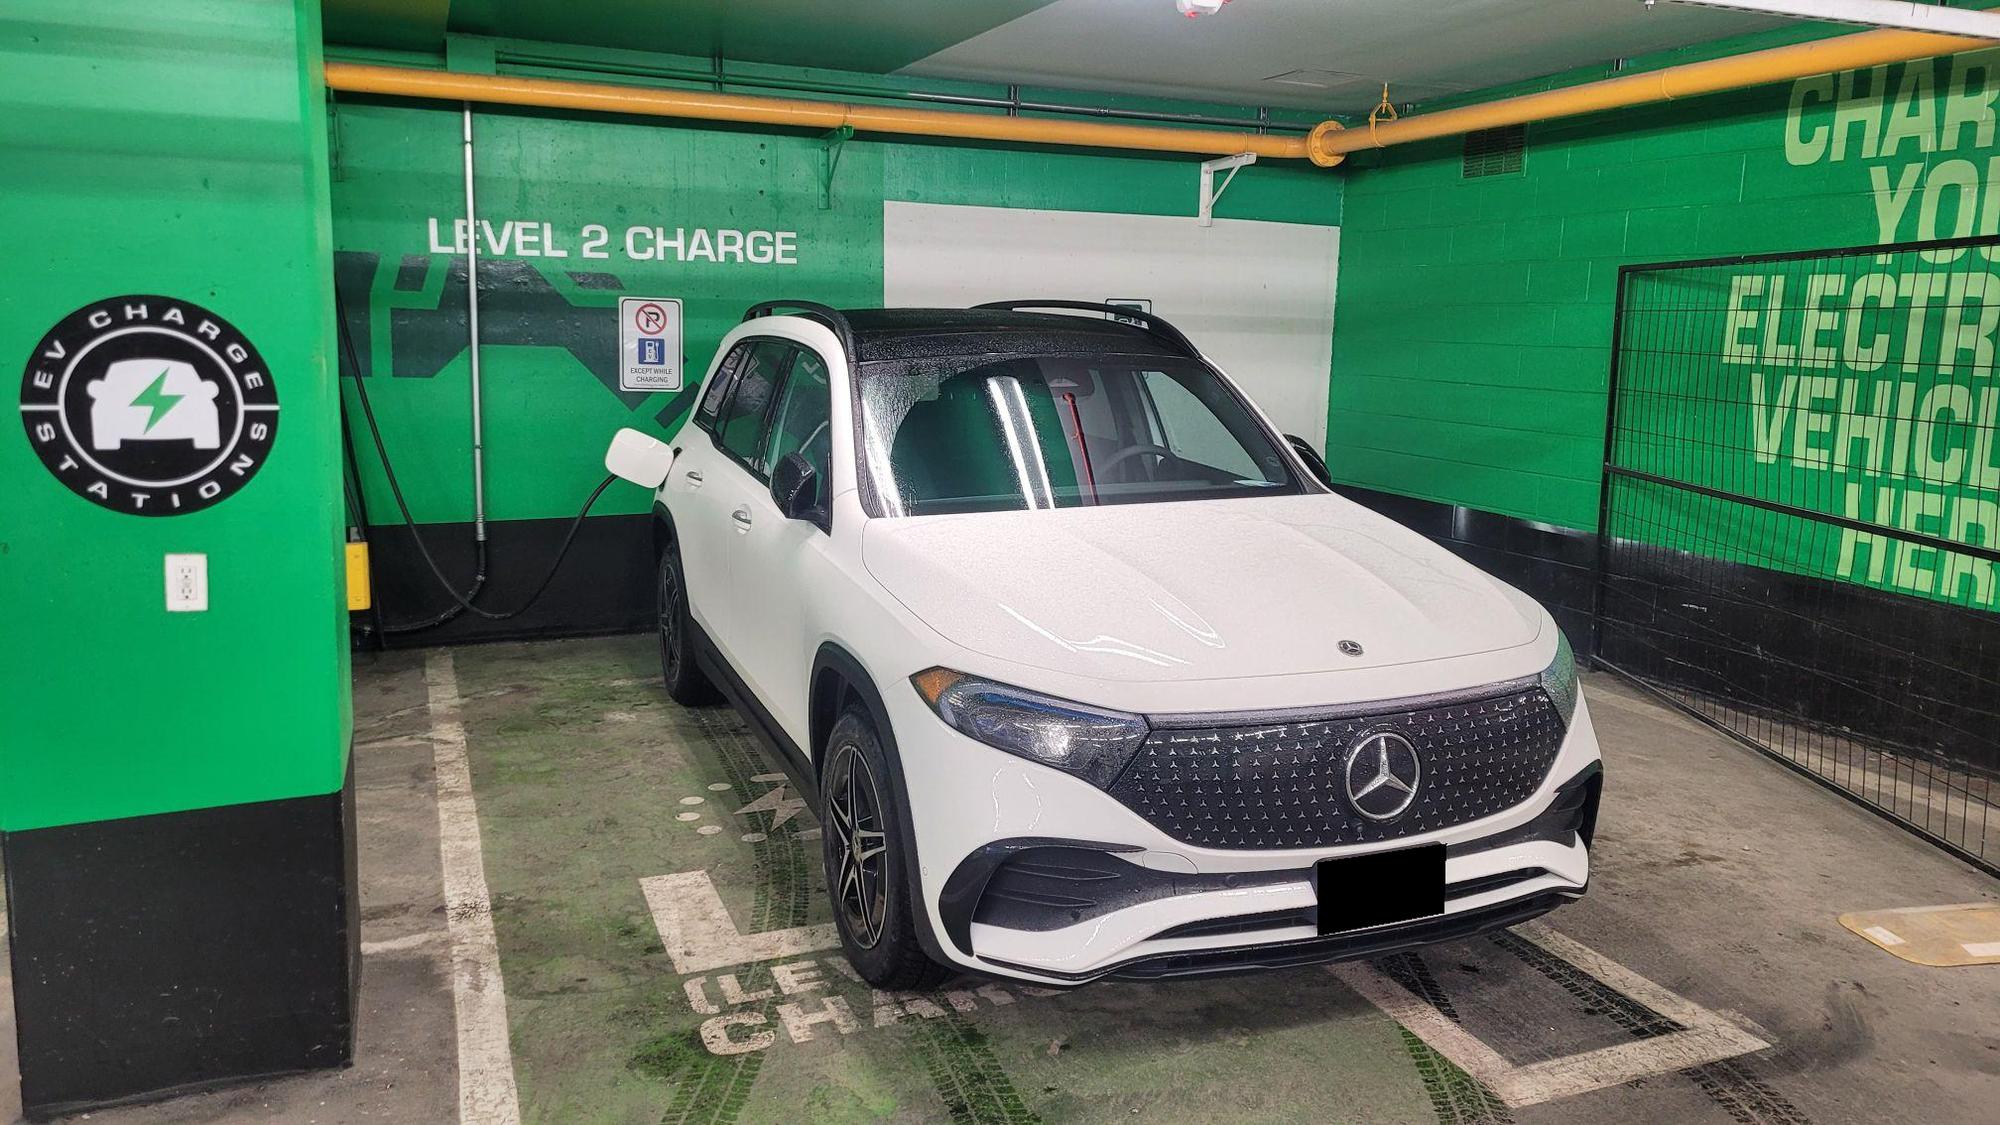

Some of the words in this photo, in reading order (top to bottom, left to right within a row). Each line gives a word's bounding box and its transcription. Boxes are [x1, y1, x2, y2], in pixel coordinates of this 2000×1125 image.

[428, 218, 568, 257] LEVEL
[581, 225, 609, 259] 2
[625, 226, 798, 264] CHARGE
[33, 339, 67, 389] EV
[88, 304, 264, 389] CHARGE
[35, 422, 267, 509] STATIONS
